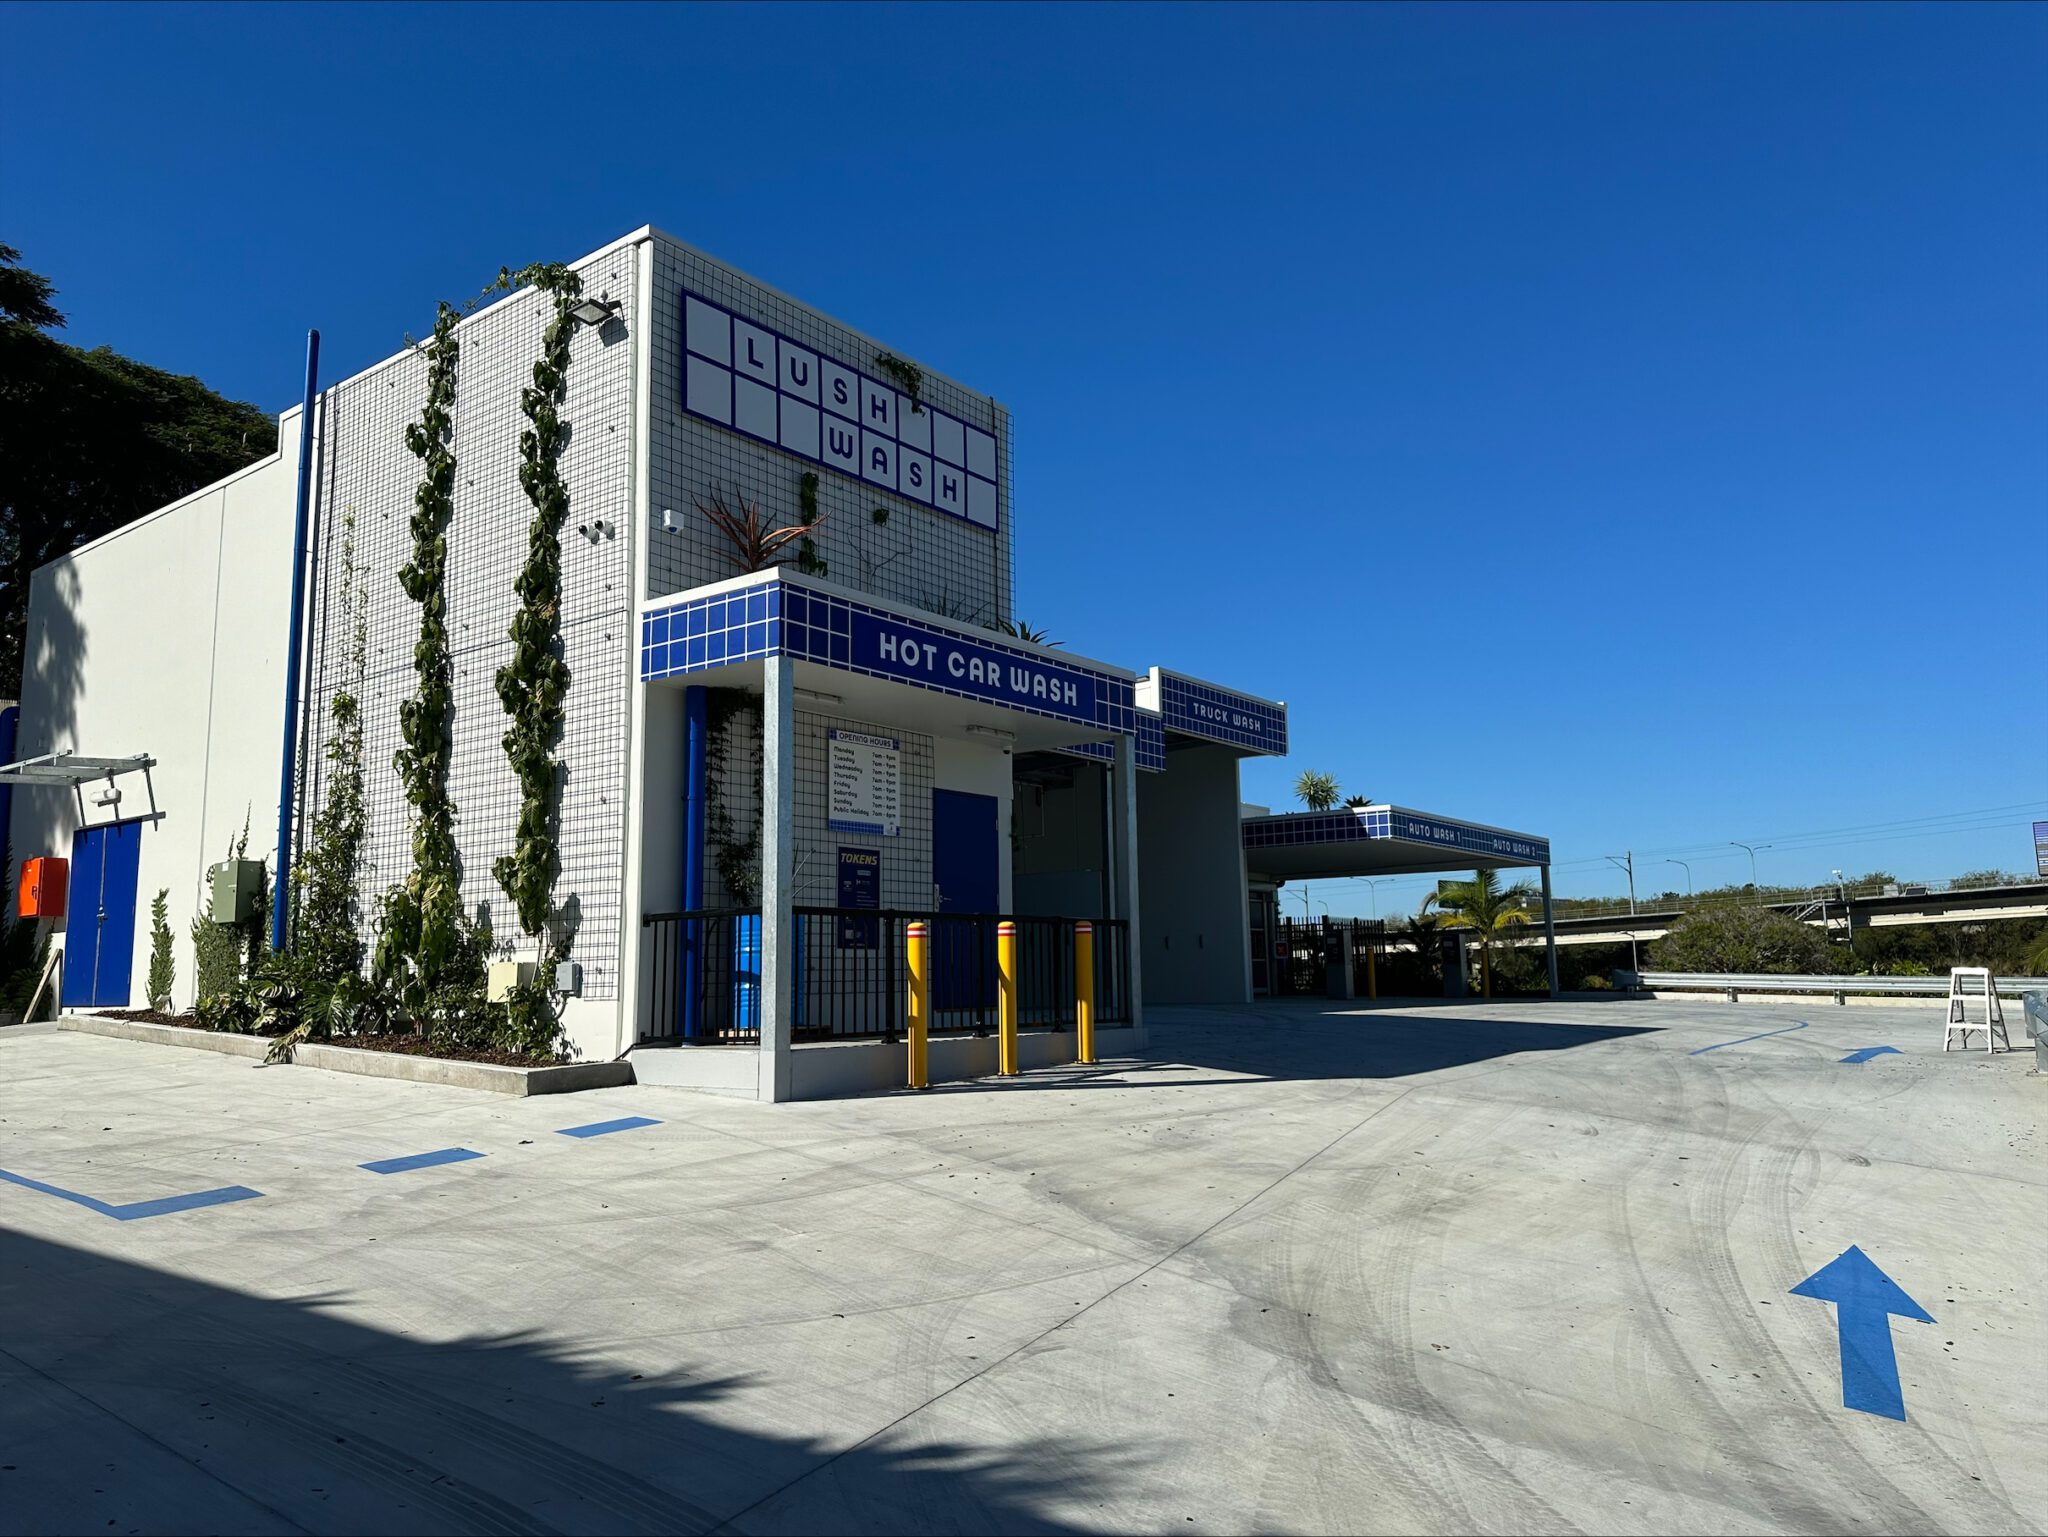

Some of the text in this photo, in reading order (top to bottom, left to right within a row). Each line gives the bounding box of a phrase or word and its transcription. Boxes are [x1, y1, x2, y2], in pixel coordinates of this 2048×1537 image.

[748, 337, 887, 423] LUSH
[829, 427, 957, 502] WASH
[880, 632, 1077, 706] HOT CAR WASH
[1193, 703, 1260, 732] TRUCK WASH
[840, 732, 891, 747] OPENING HOURS
[834, 746, 854, 755] Monday
[834, 755, 855, 764] Tuesday
[834, 764, 862, 773] Wednesday
[834, 772, 857, 781] Thursday
[834, 781, 850, 789] Friday
[834, 789, 857, 798] Saturday
[834, 798, 852, 806] Sunday
[1409, 823, 1461, 842] AUTO WASH 1
[1493, 839, 1536, 857] AUTO WASH 2
[841, 853, 878, 865] TOKENS
